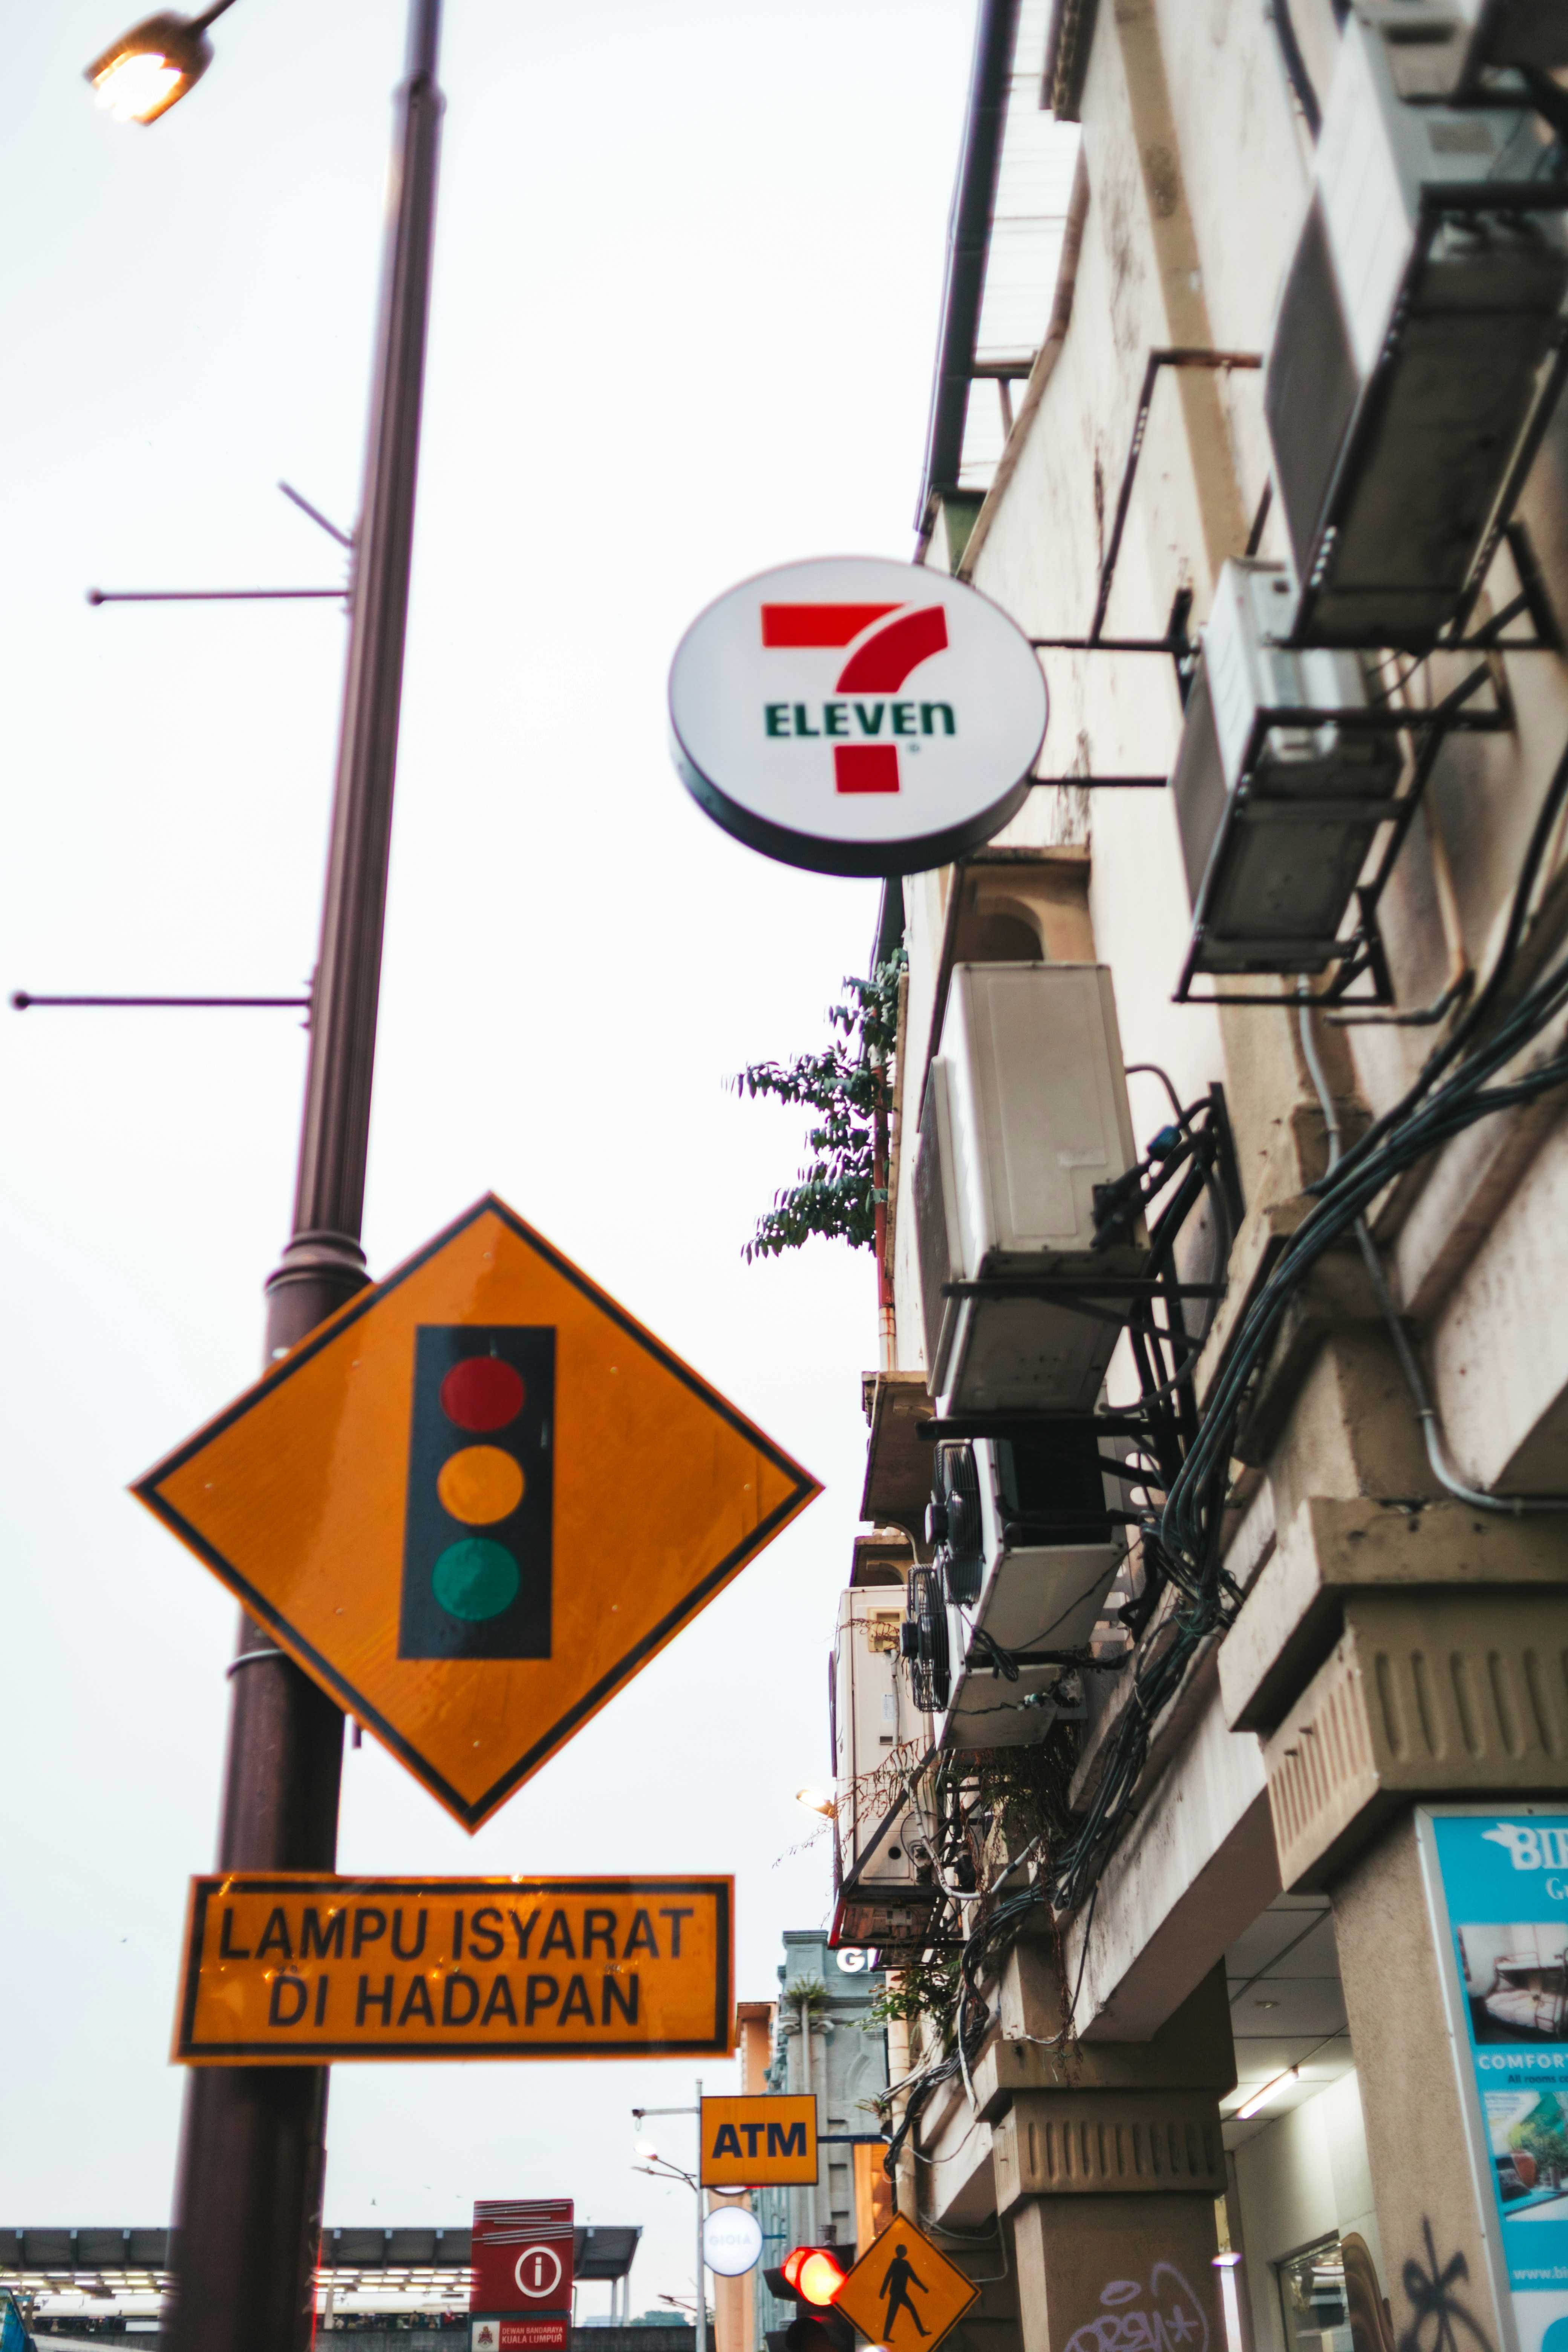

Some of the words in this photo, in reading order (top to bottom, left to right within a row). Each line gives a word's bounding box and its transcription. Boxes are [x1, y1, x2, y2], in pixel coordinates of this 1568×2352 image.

[761, 602, 949, 795] 7
[219, 1906, 428, 1962] LAMPU
[452, 1906, 695, 1962] ISYARAT
[269, 1975, 328, 2027] DI
[355, 1975, 640, 2027] HADAPAN
[1479, 2054, 1568, 2070] COMFOR
[1509, 2075, 1521, 2083] All
[712, 2122, 807, 2159] ATM
[710, 2234, 752, 2246] GIOIA
[529, 2335, 562, 2343] LUMPUR
